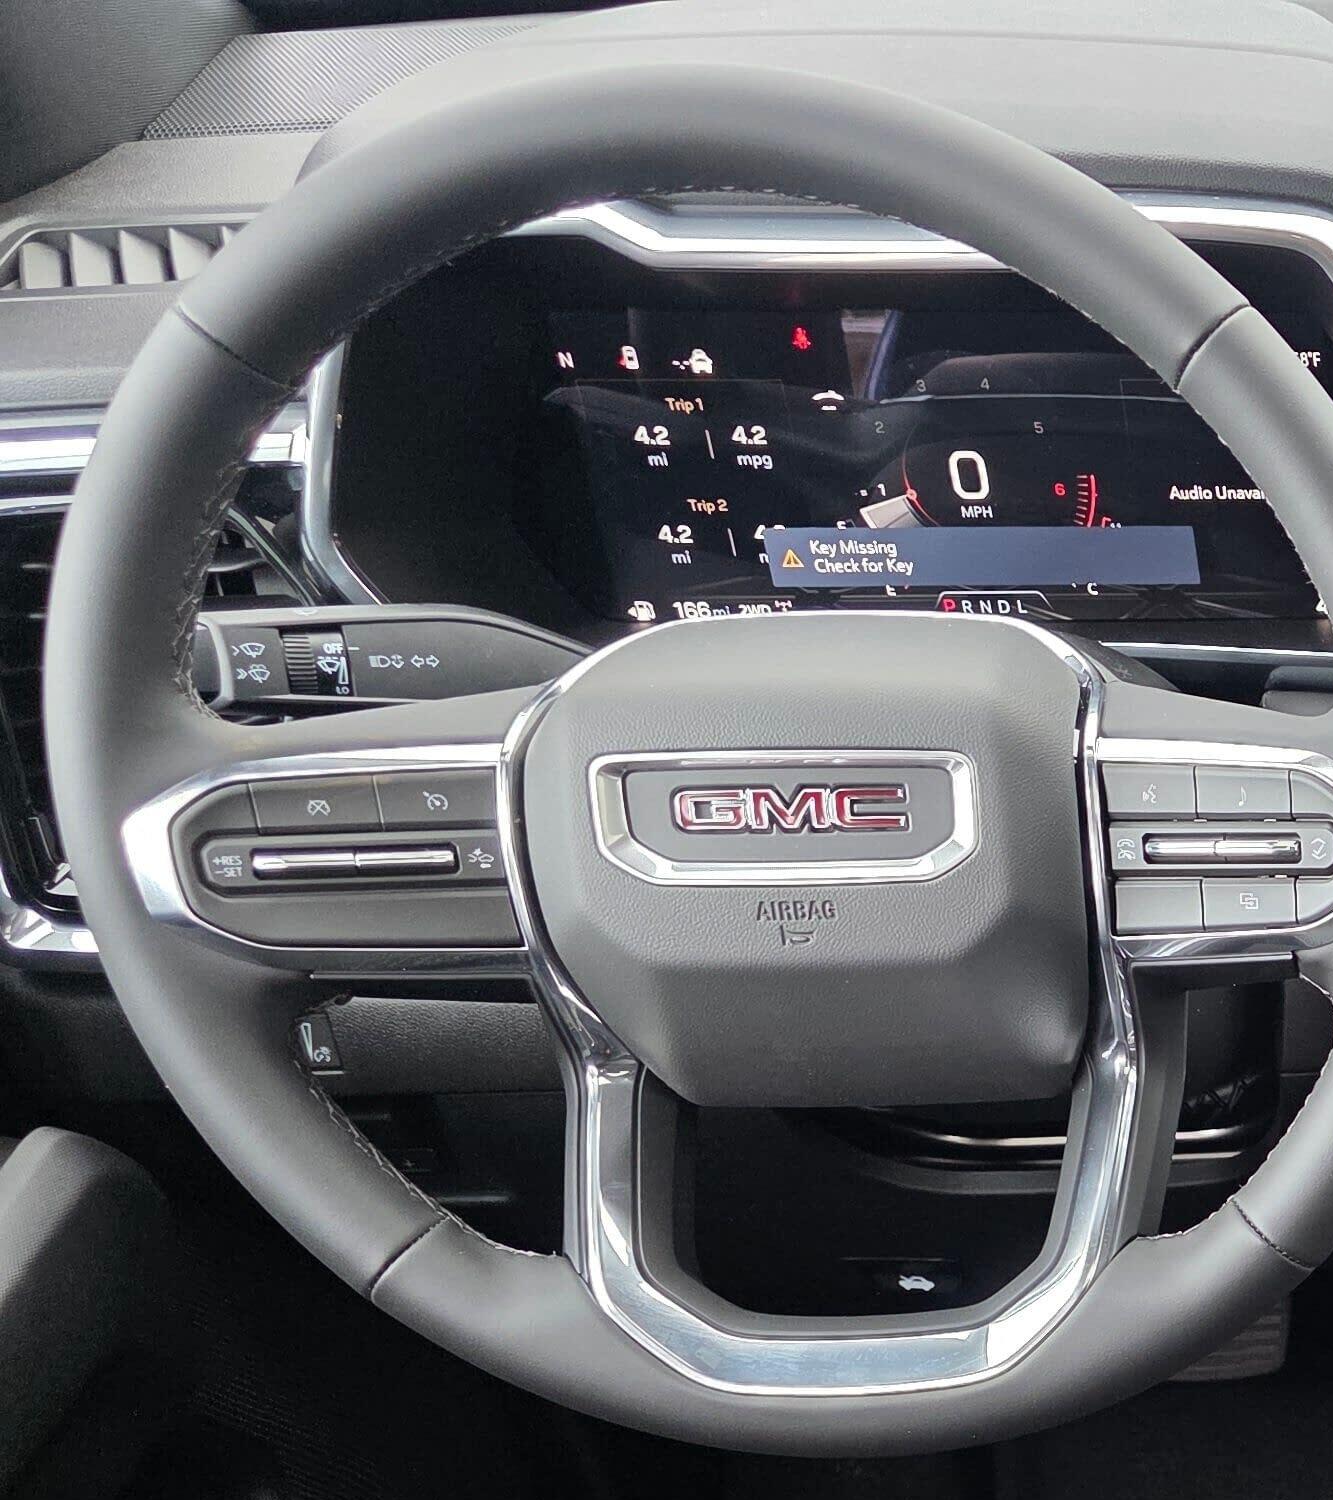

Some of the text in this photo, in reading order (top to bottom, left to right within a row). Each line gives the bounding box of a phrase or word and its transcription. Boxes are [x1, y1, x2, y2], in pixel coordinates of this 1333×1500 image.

[556, 352, 574, 369] N
[916, 380, 926, 391] 3
[980, 378, 990, 390] 4
[665, 397, 704, 414] Trip 1
[634, 425, 671, 446] 4.2
[731, 425, 767, 445] 4.2
[875, 422, 885, 434] 2
[1033, 422, 1044, 434] 5
[648, 452, 669, 467] mi
[737, 454, 773, 470] mpg
[949, 450, 990, 500] 0
[1054, 483, 1066, 496] 6
[1169, 485, 1212, 500] Audio
[687, 499, 728, 515] Trip 2
[961, 505, 993, 519] MPH
[658, 525, 693, 544] 4.2
[672, 550, 692, 564] mi
[809, 540, 898, 558] Key Missing
[814, 557, 914, 576] Check for Key
[672, 601, 713, 618] 166
[943, 599, 1028, 613] P R N D L
[676, 787, 906, 831] GMC
[755, 901, 837, 922] AIRBAG
